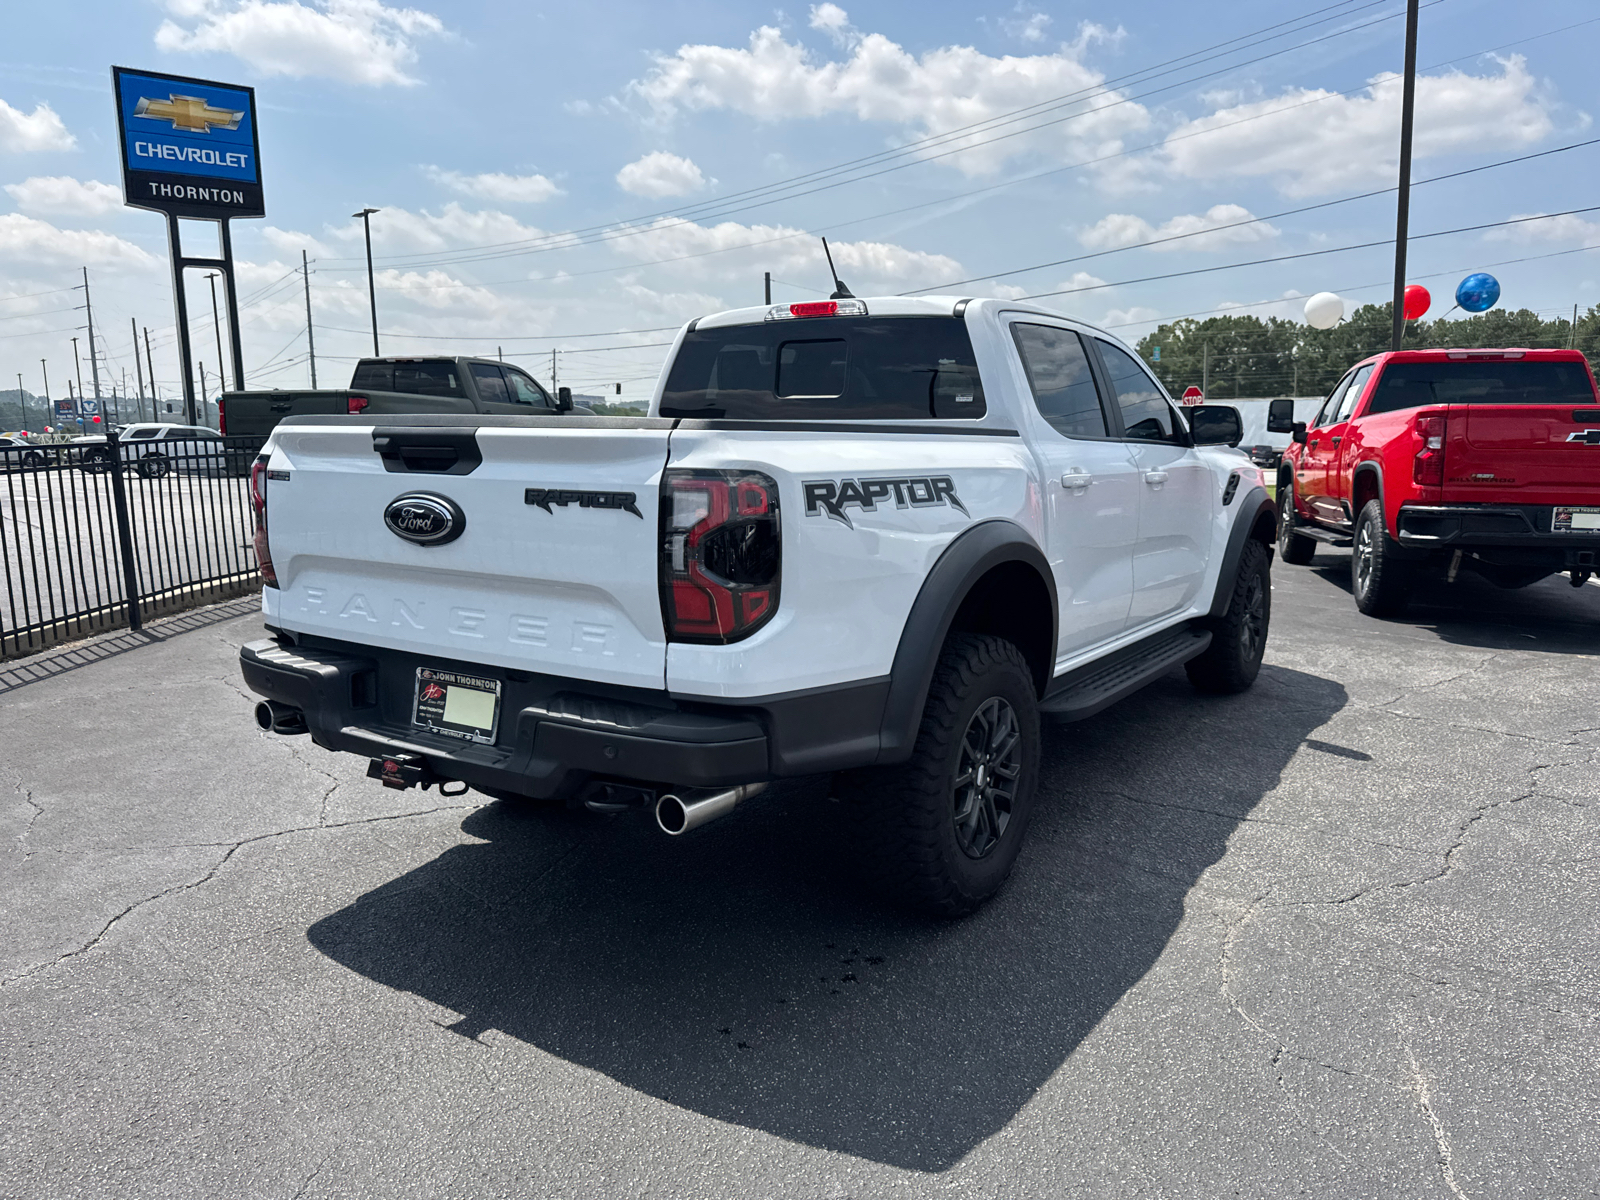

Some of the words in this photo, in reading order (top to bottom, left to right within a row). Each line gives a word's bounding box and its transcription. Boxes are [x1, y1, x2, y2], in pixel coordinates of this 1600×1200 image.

[135, 141, 248, 168] CHEVROLET
[149, 182, 244, 204] THORNTON
[1184, 395, 1202, 406] STOP
[524, 487, 644, 520] RAPTOR
[801, 474, 971, 530] RAPTOR
[398, 506, 434, 532] Ford
[300, 585, 614, 656] RANGER
[436, 672, 456, 683] JOHN
[456, 676, 496, 690] THORNTON
[440, 730, 464, 738] CHEVROLET
